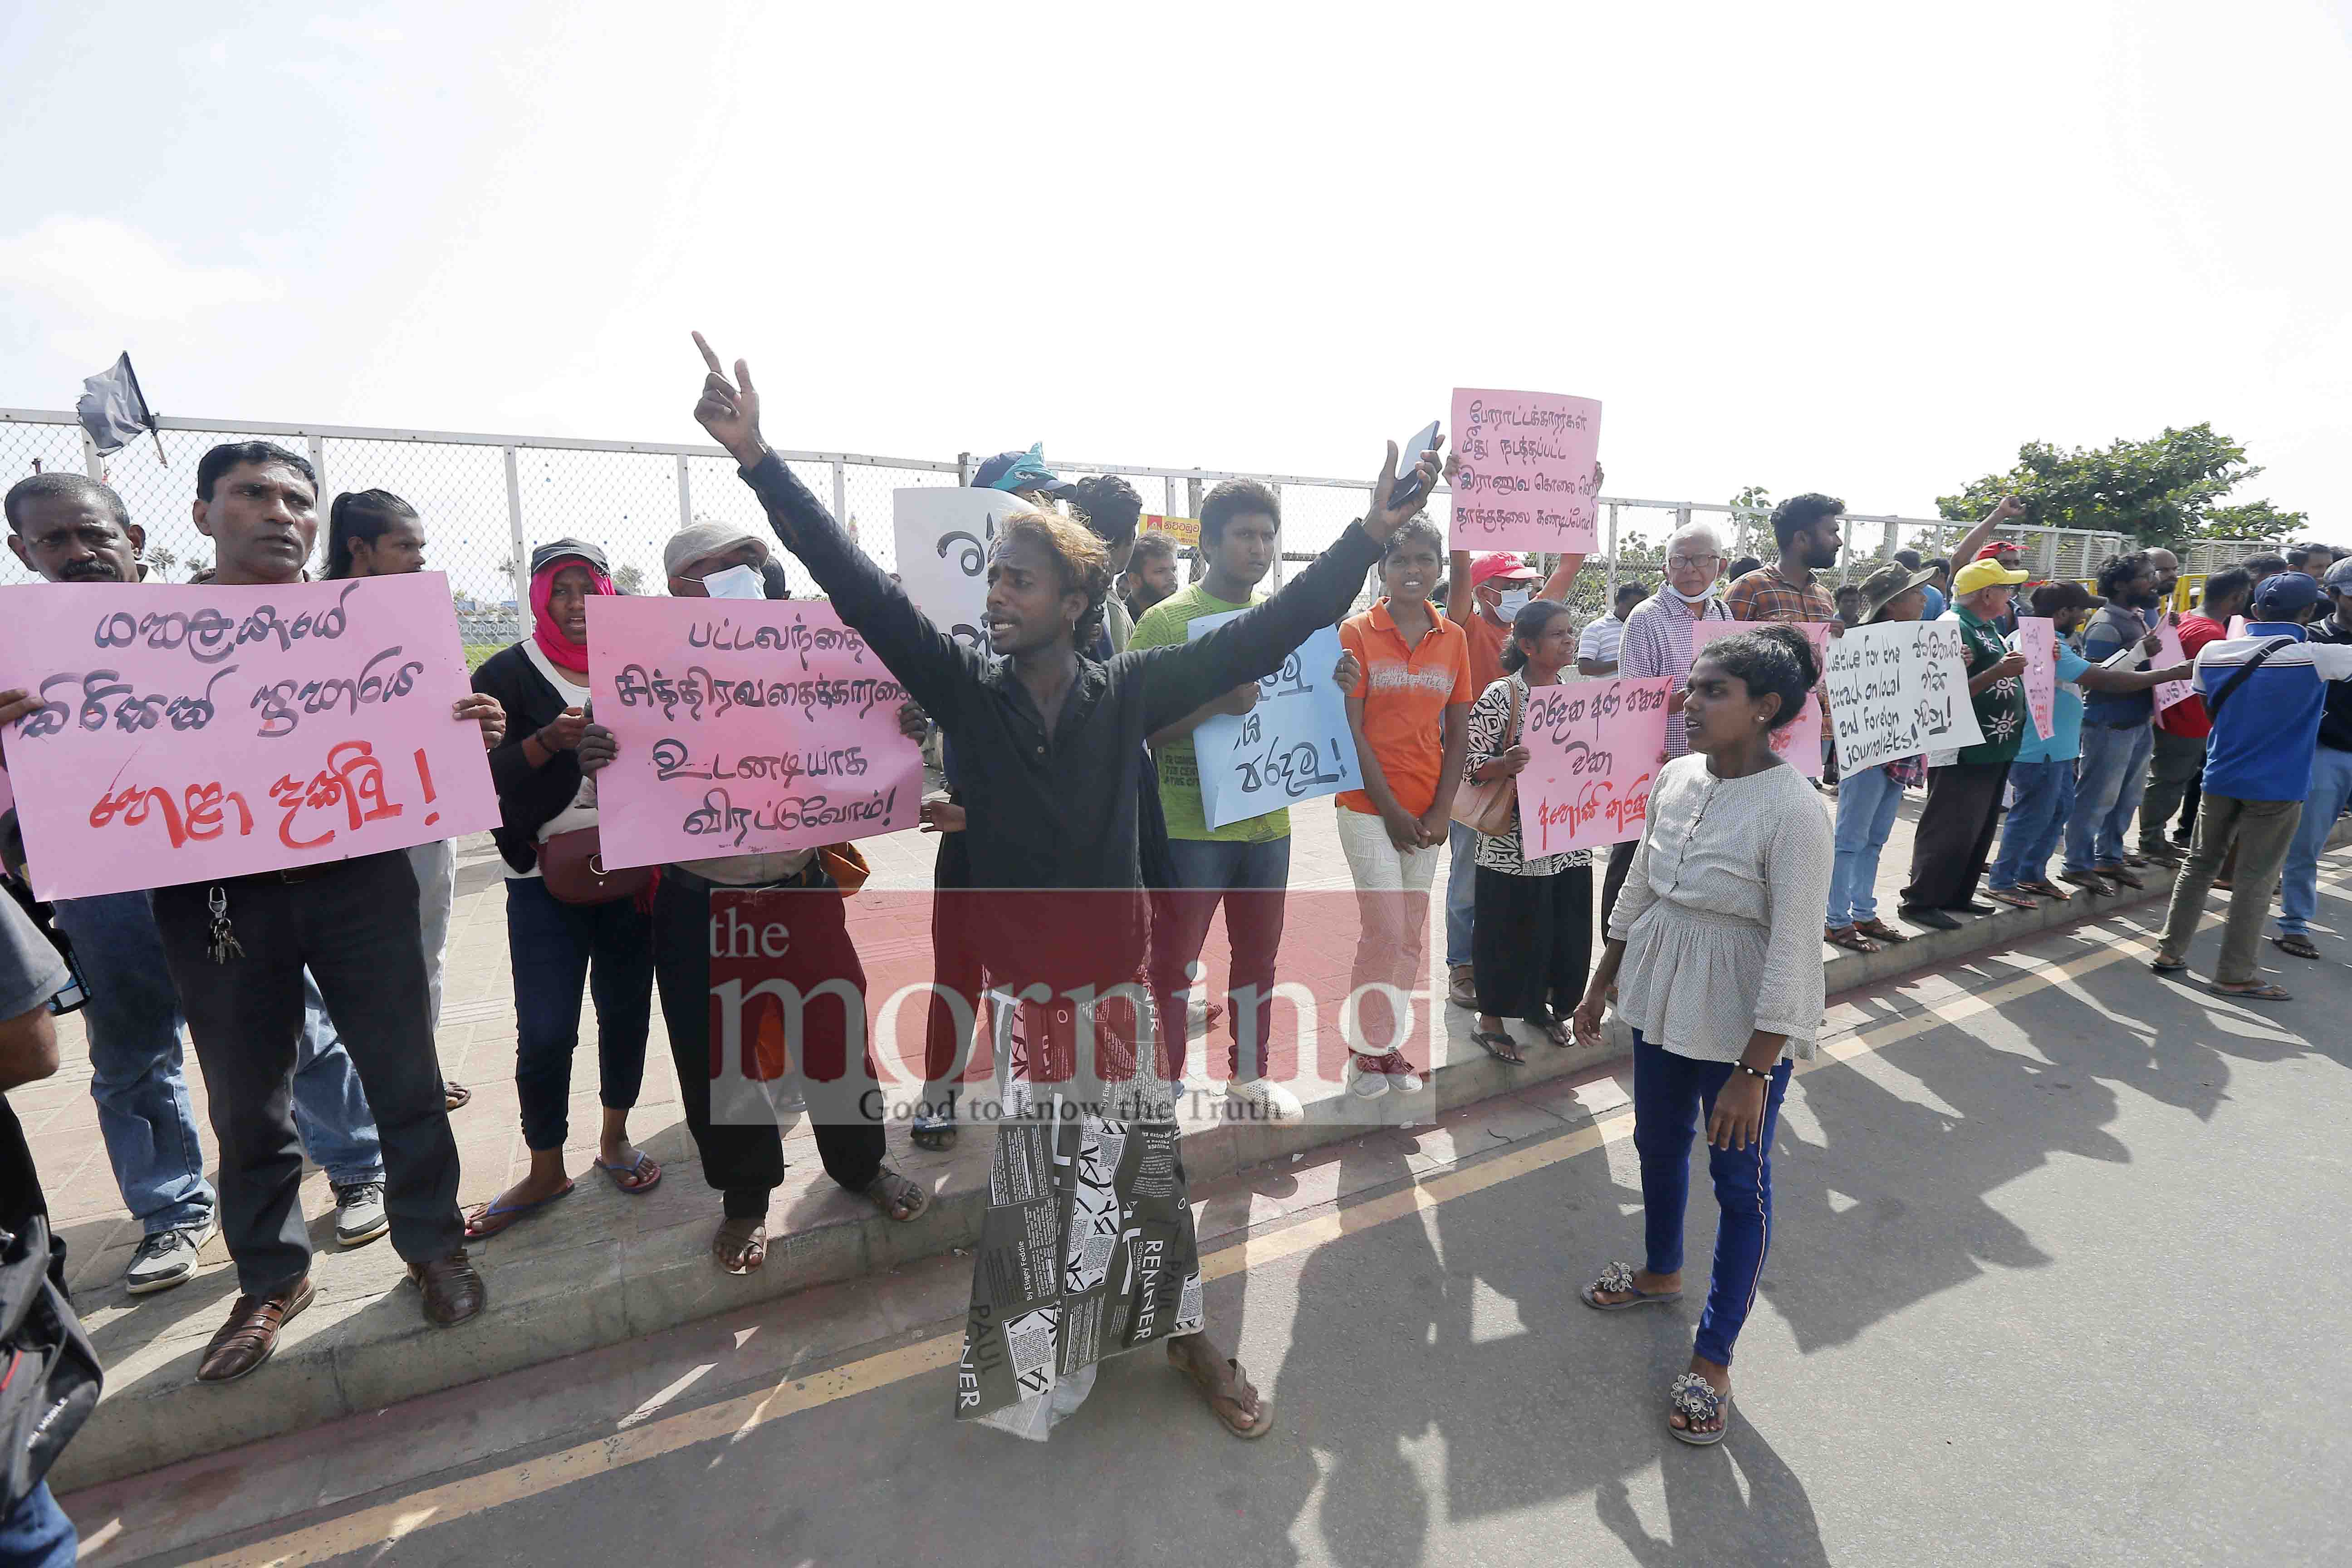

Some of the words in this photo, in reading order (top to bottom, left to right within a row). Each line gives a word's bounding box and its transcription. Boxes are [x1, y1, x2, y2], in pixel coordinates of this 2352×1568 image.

[1882, 635, 1901, 664] the
[1829, 672, 1862, 709] attack
[1840, 709, 1859, 738] and
[1133, 1240, 1164, 1341] RENNER
